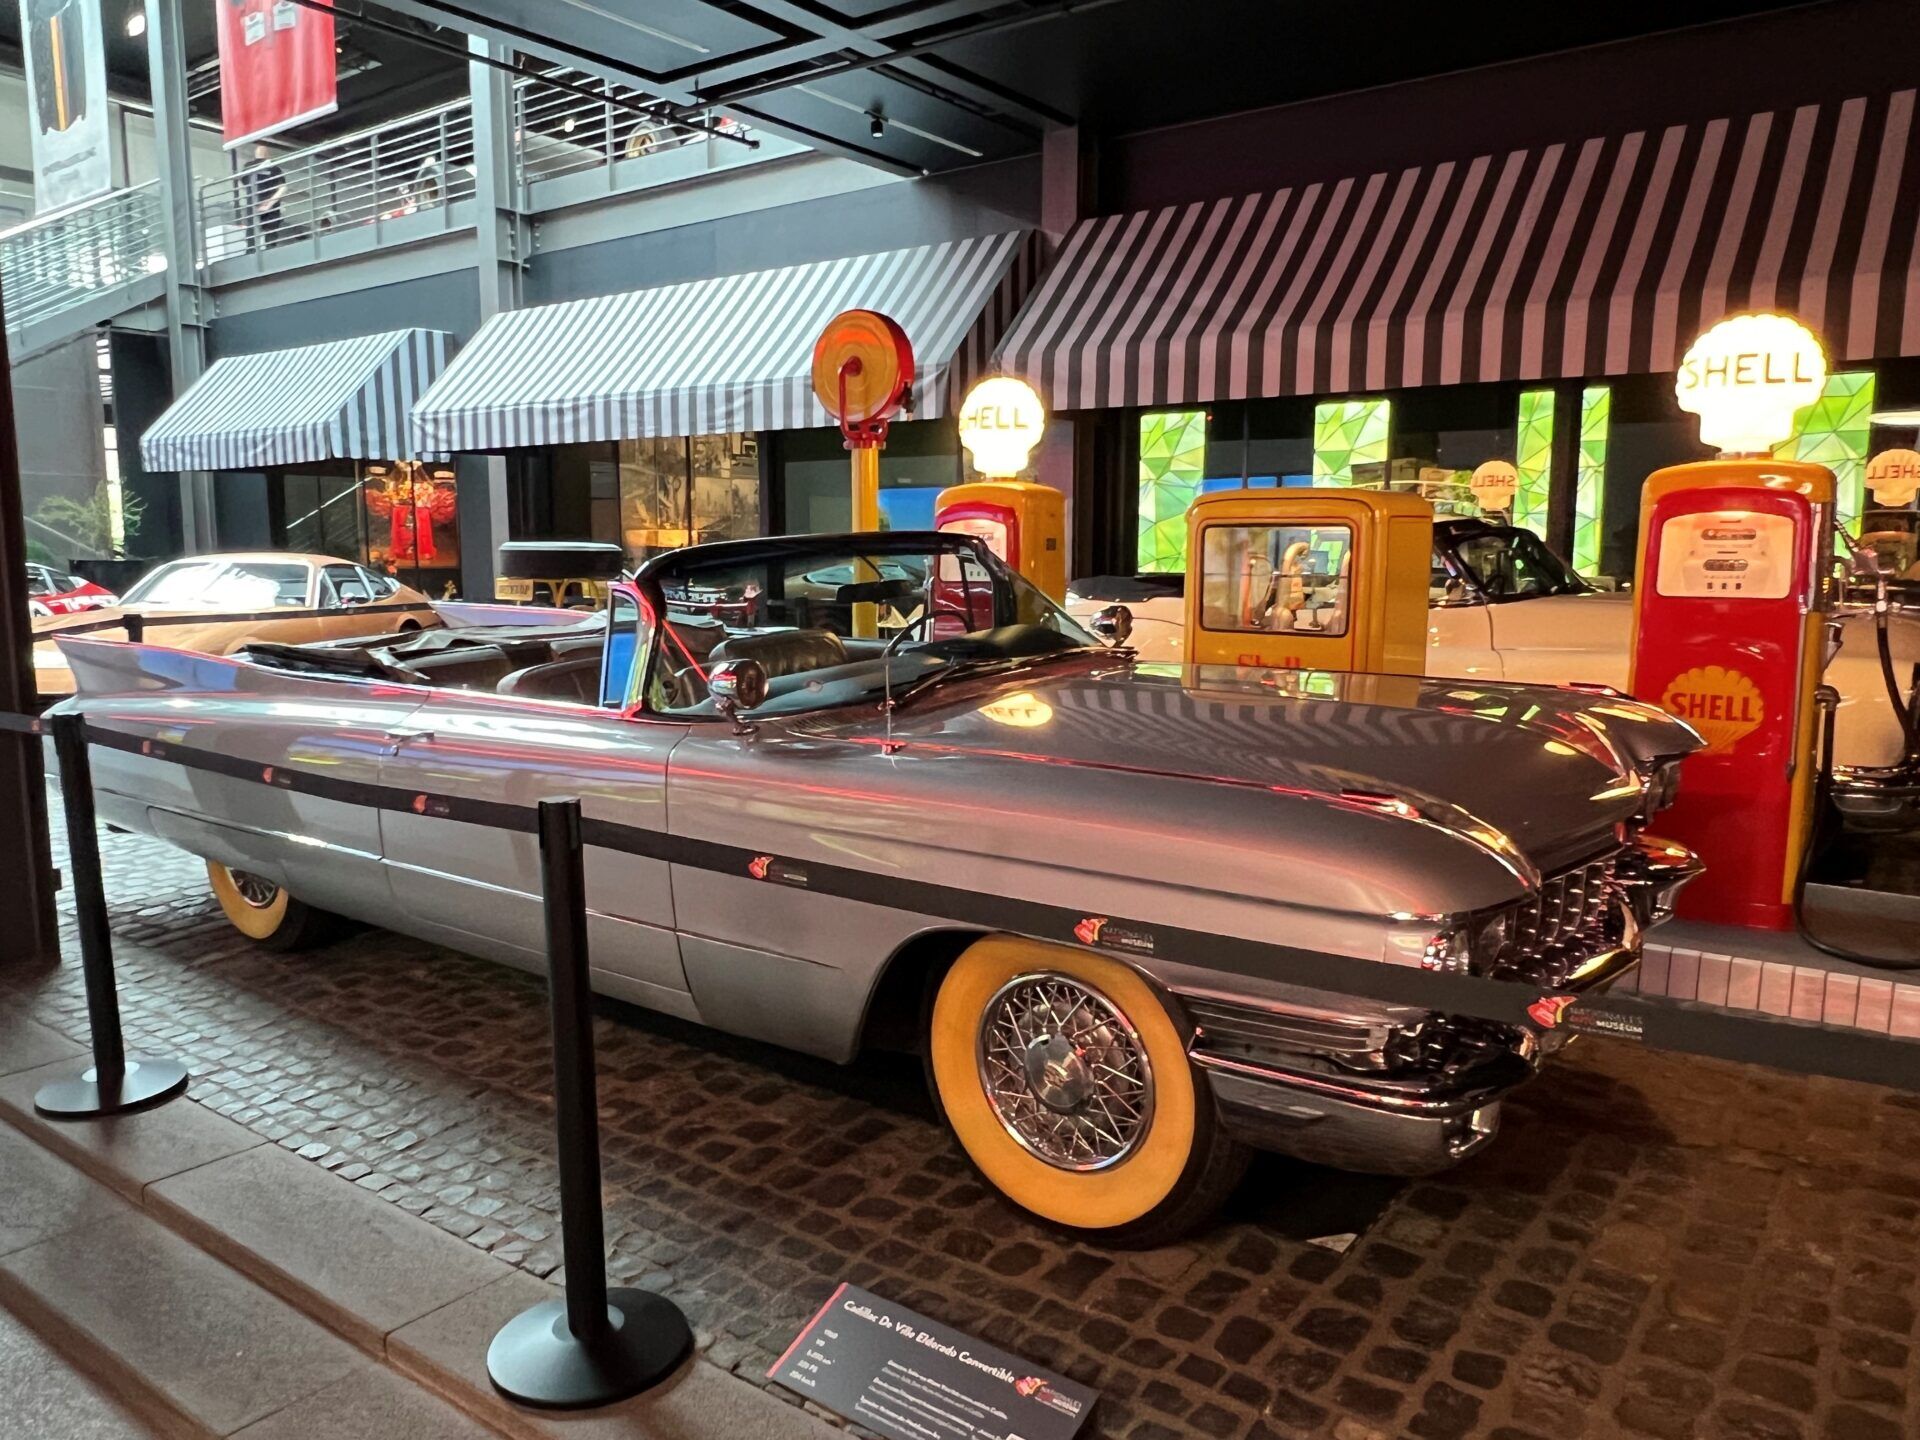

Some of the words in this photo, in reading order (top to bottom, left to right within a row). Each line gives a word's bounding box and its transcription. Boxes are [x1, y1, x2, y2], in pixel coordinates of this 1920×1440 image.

[1685, 352, 1812, 389] SHELL
[959, 405, 1028, 432] HELL
[1238, 654, 1300, 667] Shll
[1670, 692, 1756, 722] SHELL
[844, 1300, 879, 1323] Cadillac
[879, 1315, 893, 1329] De
[895, 1322, 916, 1339] Ville
[916, 1332, 957, 1358] Eldorado
[959, 1351, 1015, 1384] Convertible
